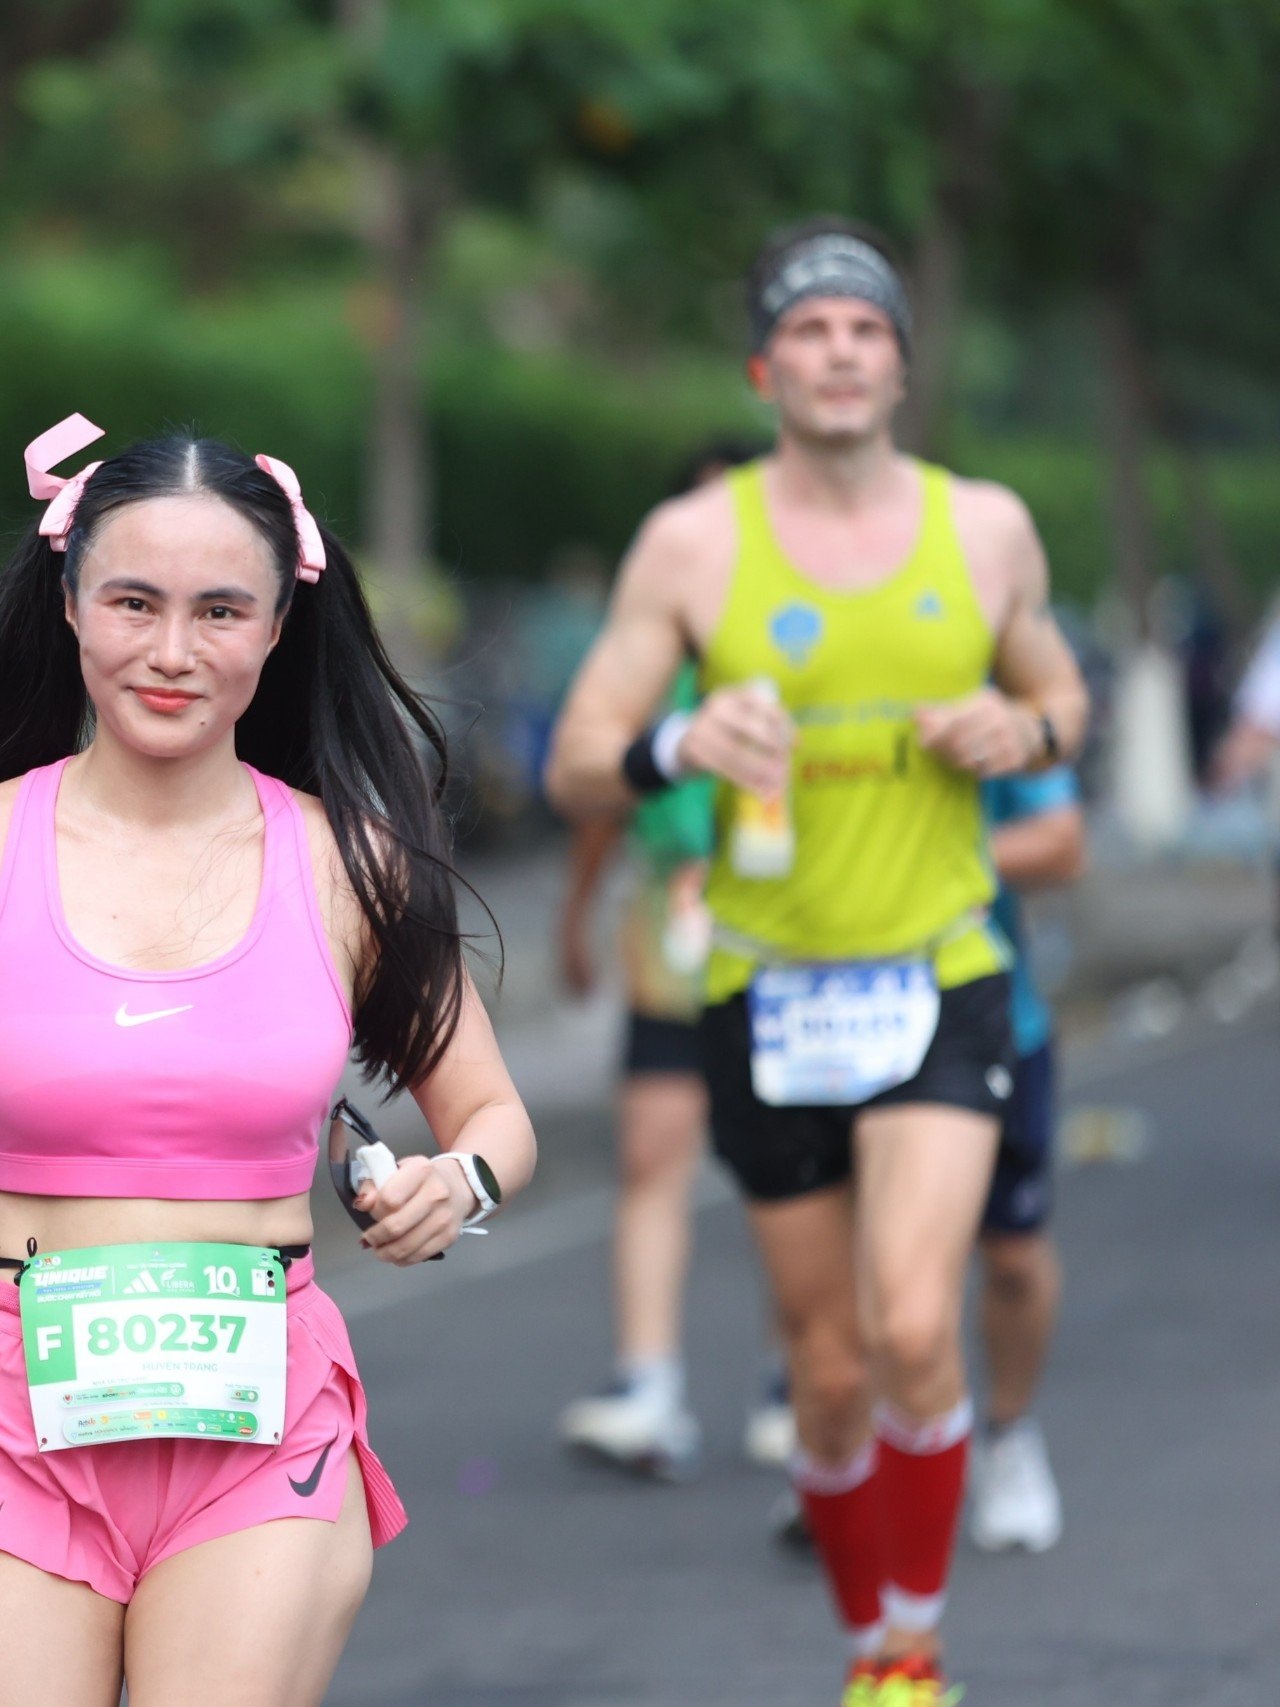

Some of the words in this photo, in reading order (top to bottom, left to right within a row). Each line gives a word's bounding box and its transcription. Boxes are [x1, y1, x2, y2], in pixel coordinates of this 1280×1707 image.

[29, 1266, 108, 1287] UNIQUE
[36, 1325, 62, 1361] F
[87, 1314, 247, 1356] 80237
